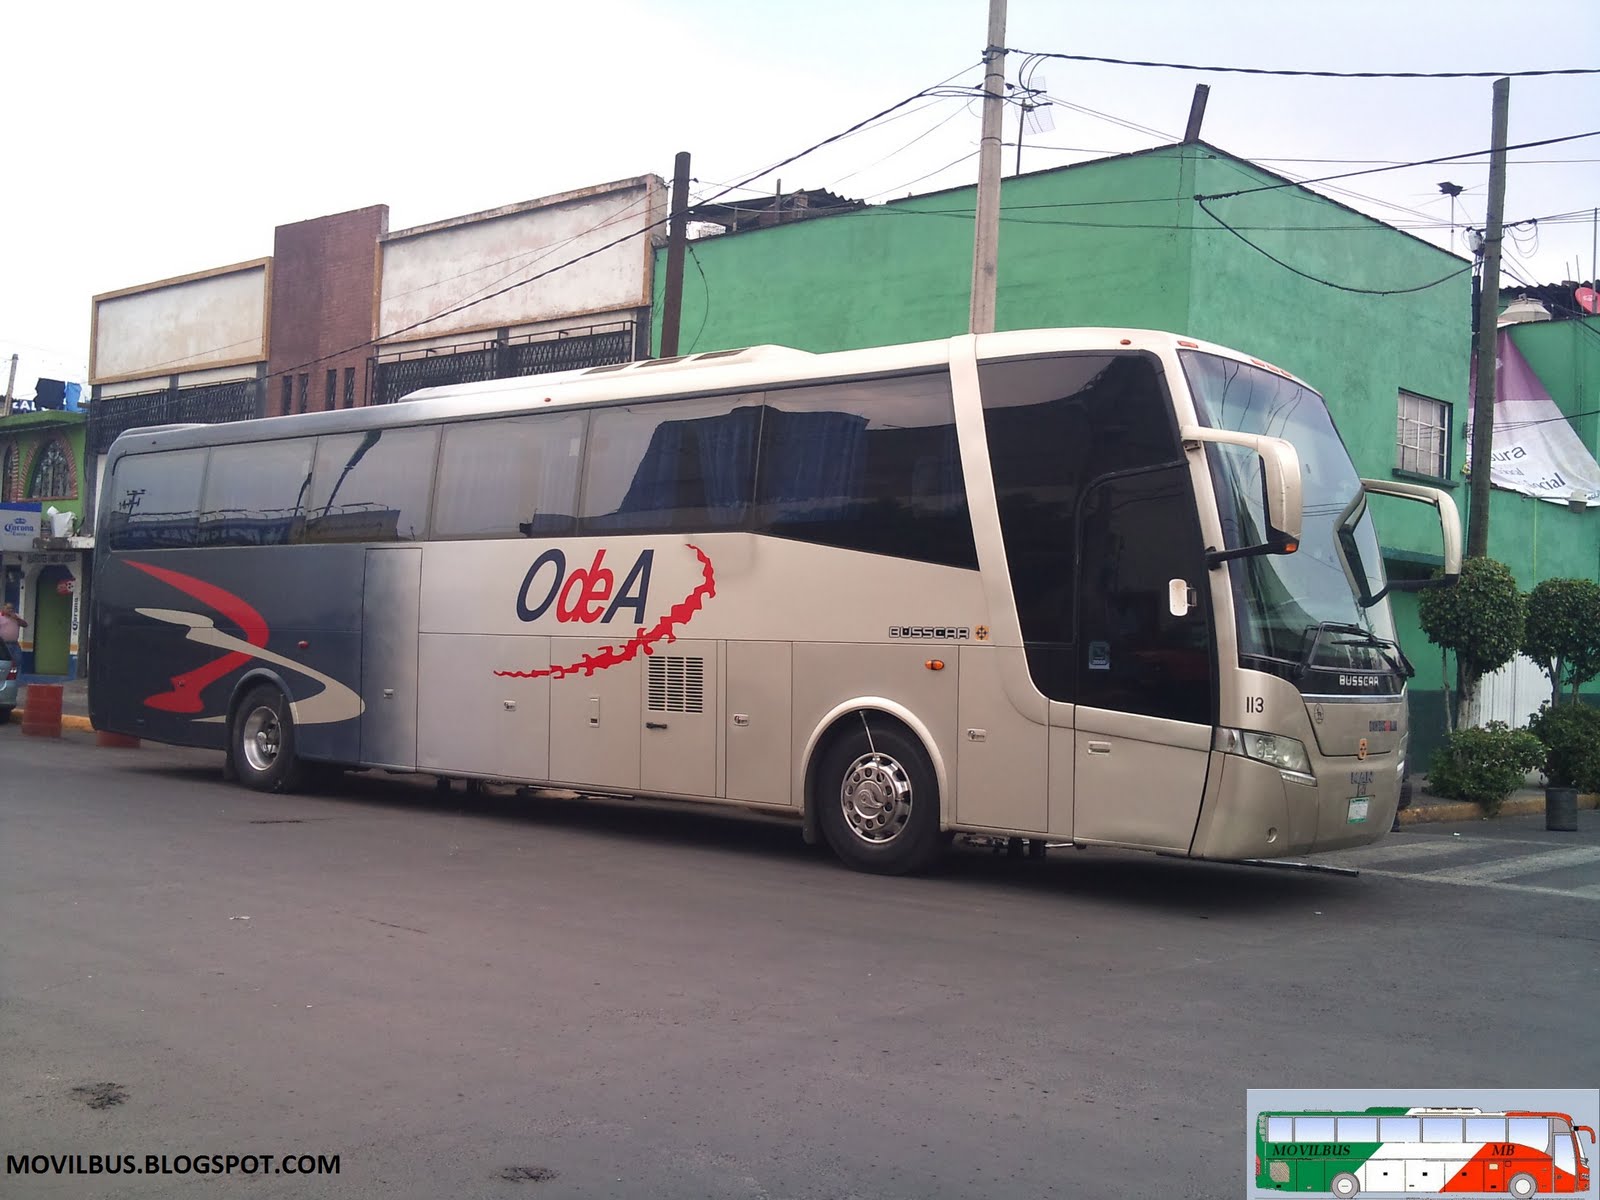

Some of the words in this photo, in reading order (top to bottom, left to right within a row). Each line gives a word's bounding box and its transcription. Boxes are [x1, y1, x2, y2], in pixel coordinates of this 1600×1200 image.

[4, 523, 34, 533] Corona
[71, 597, 79, 631] Corona
[889, 626, 970, 639] BUSSCAR
[1339, 675, 1379, 686] BUSSCAR
[1246, 696, 1264, 713] 113
